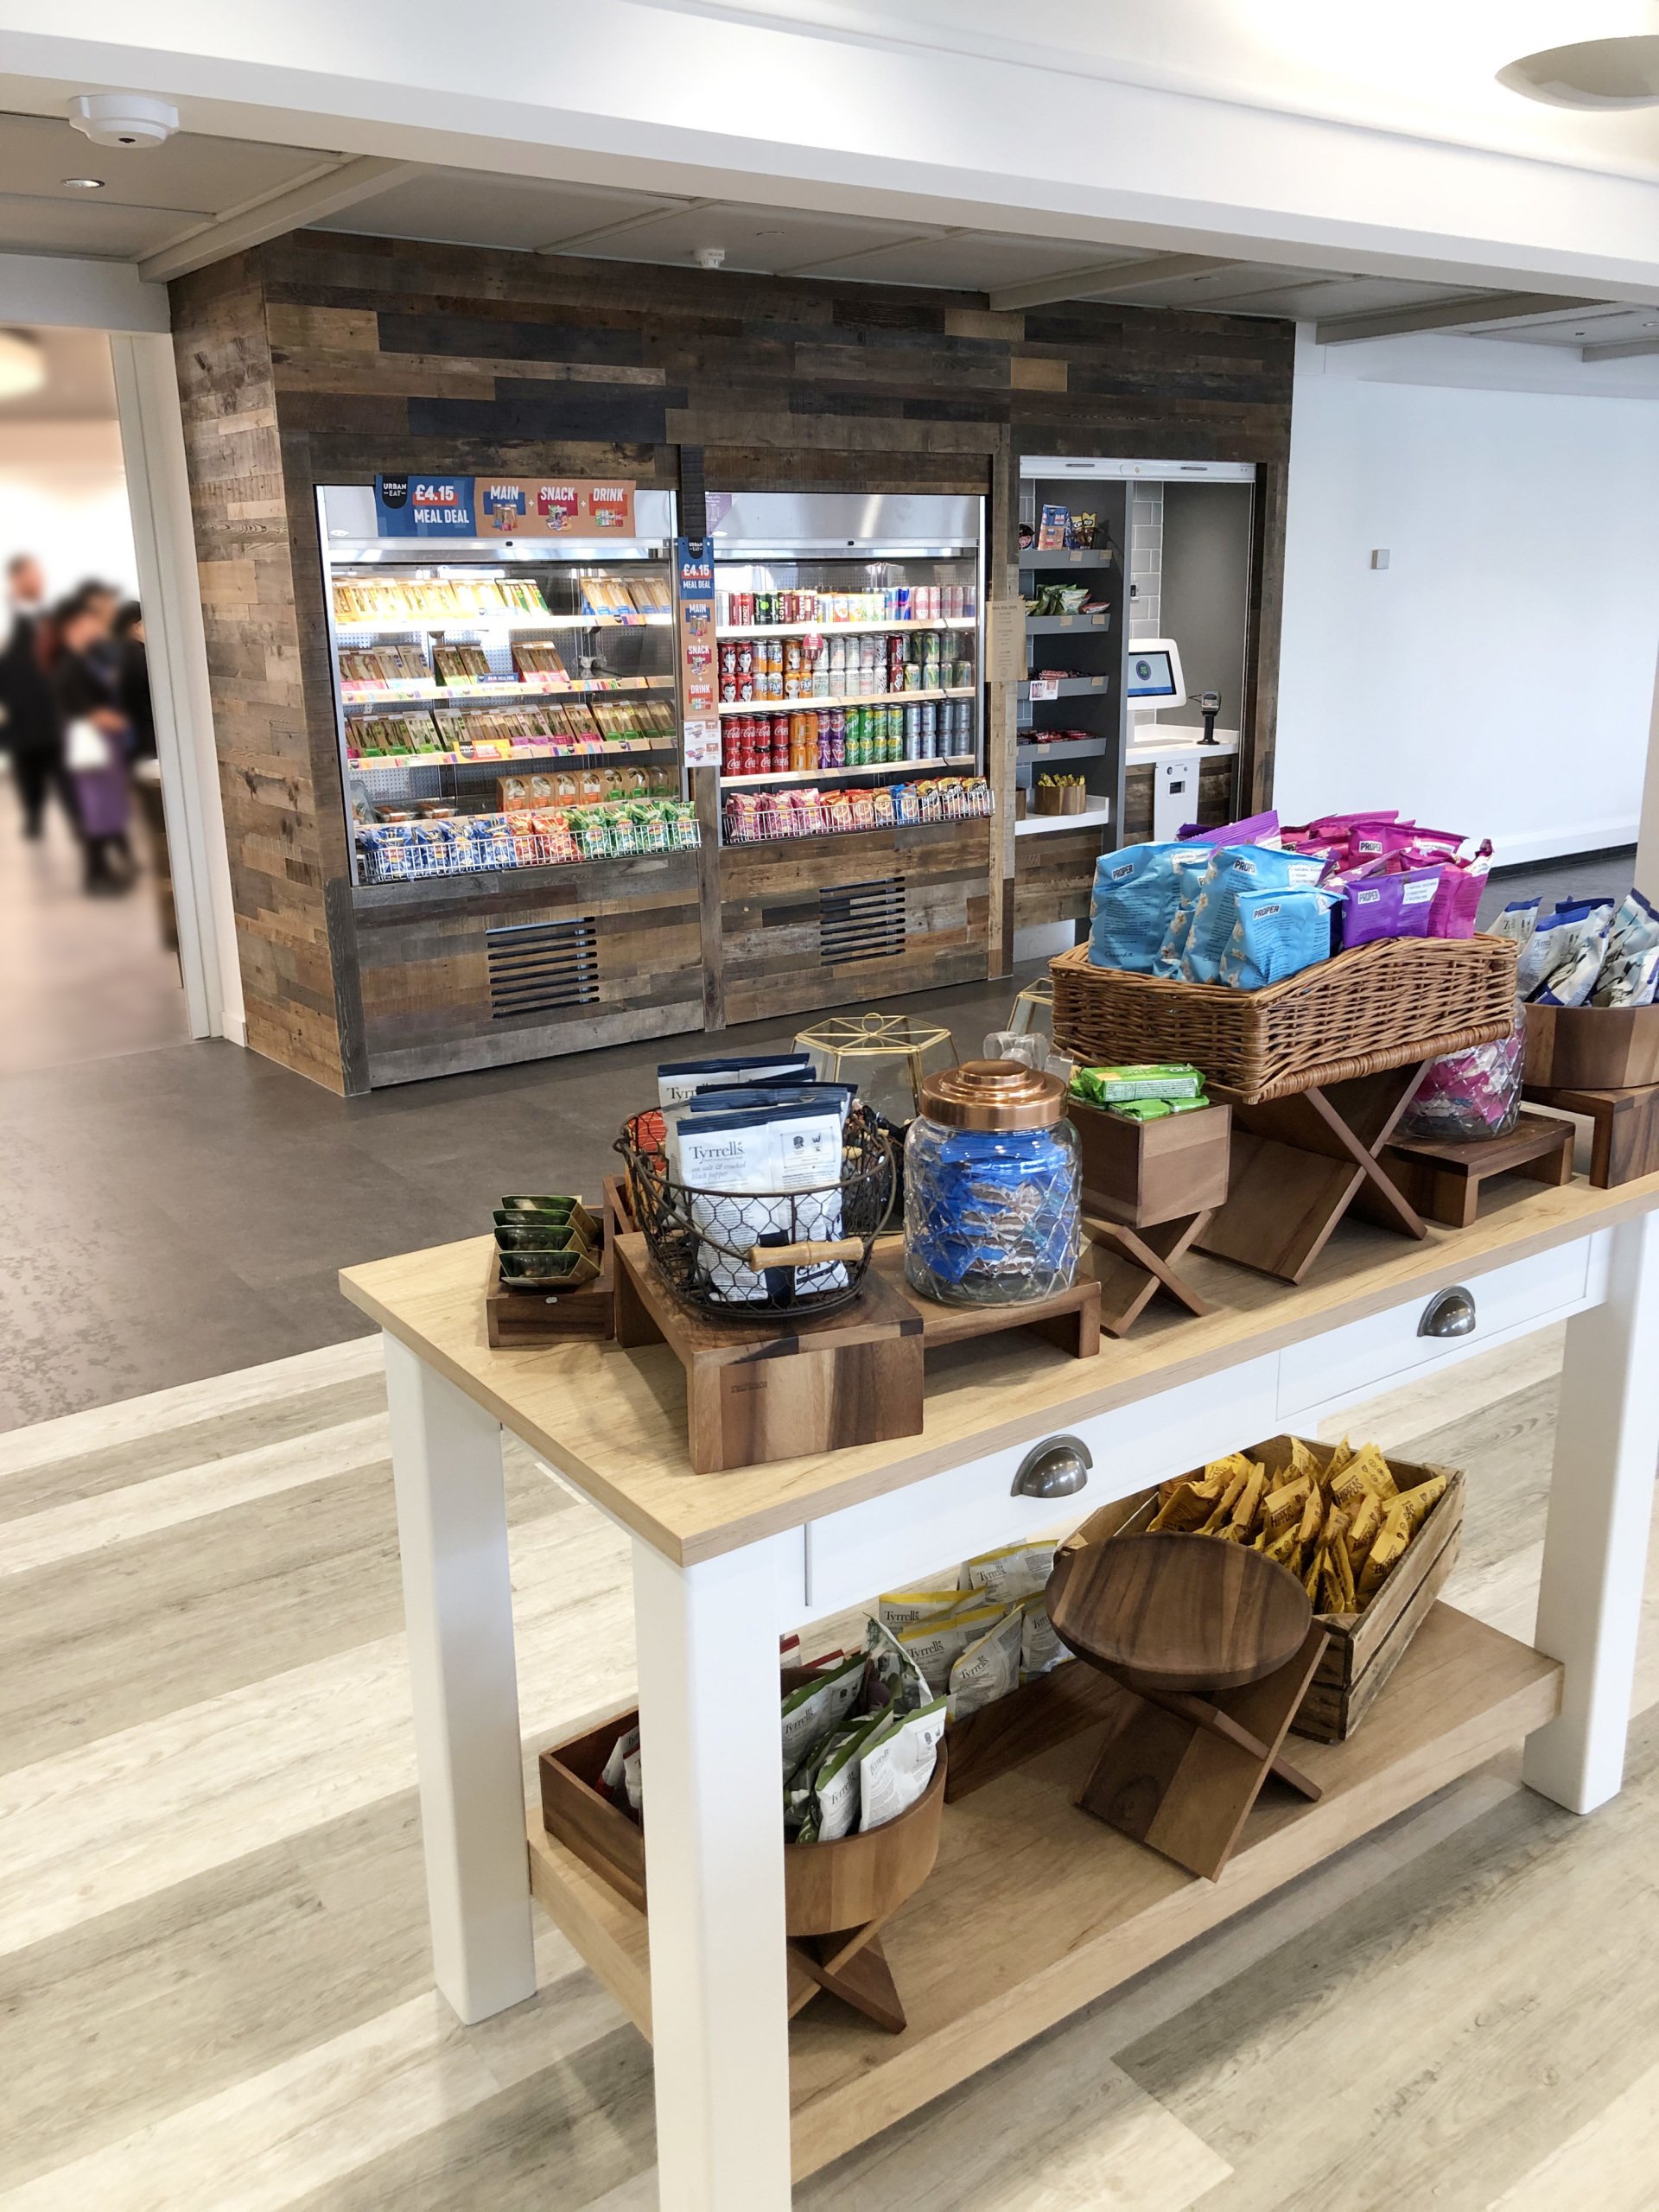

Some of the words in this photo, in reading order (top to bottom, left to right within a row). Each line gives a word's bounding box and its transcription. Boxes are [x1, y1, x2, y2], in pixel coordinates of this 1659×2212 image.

[416, 484, 454, 501] £4.15
[490, 486, 518, 500] MAIN
[540, 486, 575, 501] SNACK
[593, 488, 624, 502] DRINK
[414, 509, 443, 524] MEAL
[444, 510, 470, 524] DEAL
[683, 563, 709, 576] £4.15
[683, 580, 697, 589] MEAL
[697, 580, 711, 589] DEAL
[689, 604, 707, 613] MAIN
[688, 645, 710, 655] SNACK
[690, 684, 710, 694] DRINK
[1112, 864, 1134, 880] PROPER
[1358, 891, 1379, 904] PROPER
[1254, 905, 1280, 919] PROPER
